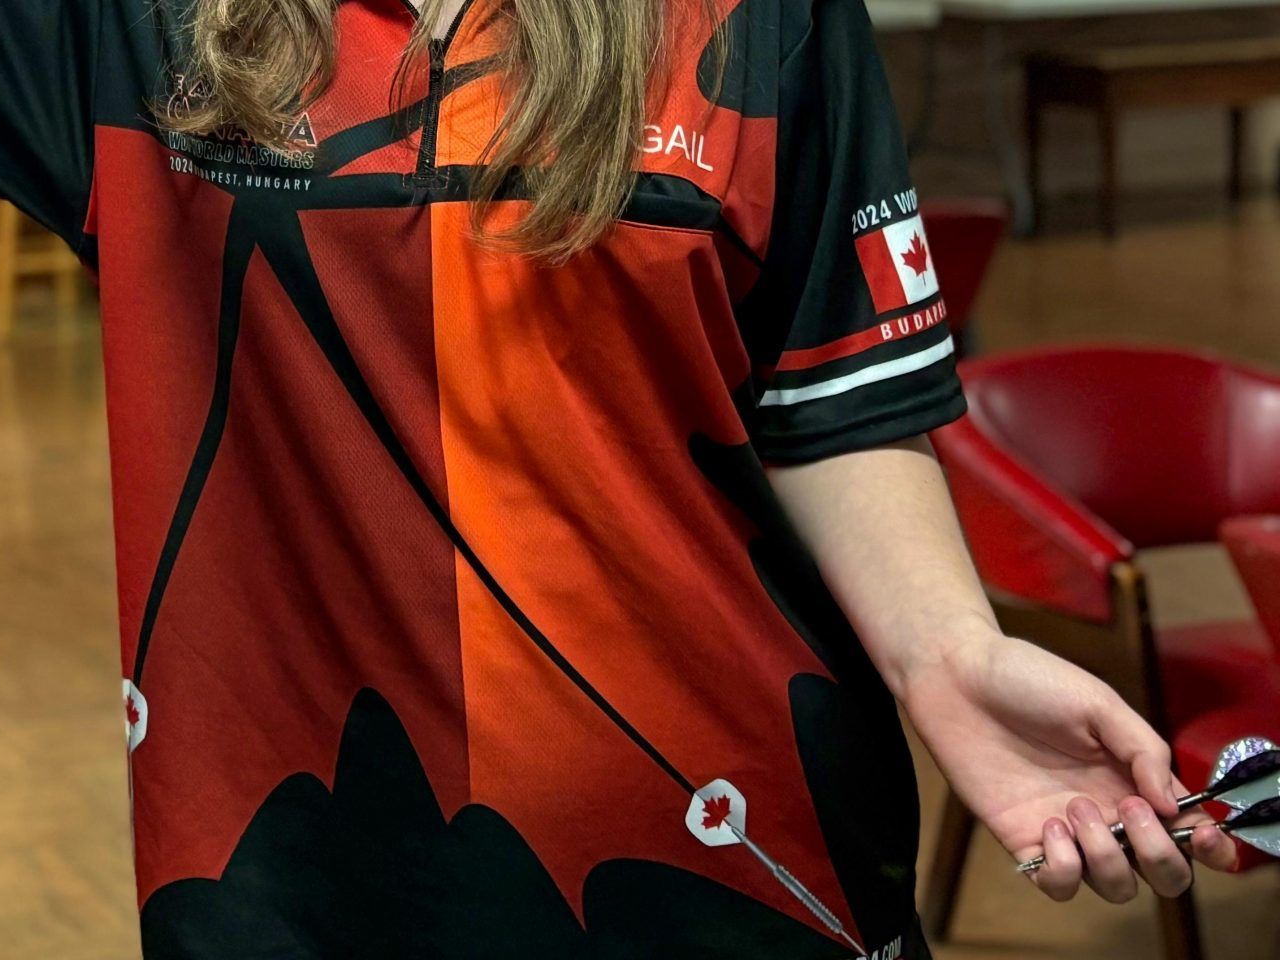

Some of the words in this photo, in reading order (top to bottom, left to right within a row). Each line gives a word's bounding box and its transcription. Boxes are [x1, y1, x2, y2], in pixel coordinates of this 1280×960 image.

[193, 138, 235, 164] ORLD
[236, 145, 315, 170] MASTERS
[170, 155, 193, 174] 2024
[246, 175, 311, 191] HUNGARY
[852, 199, 891, 235] 2024
